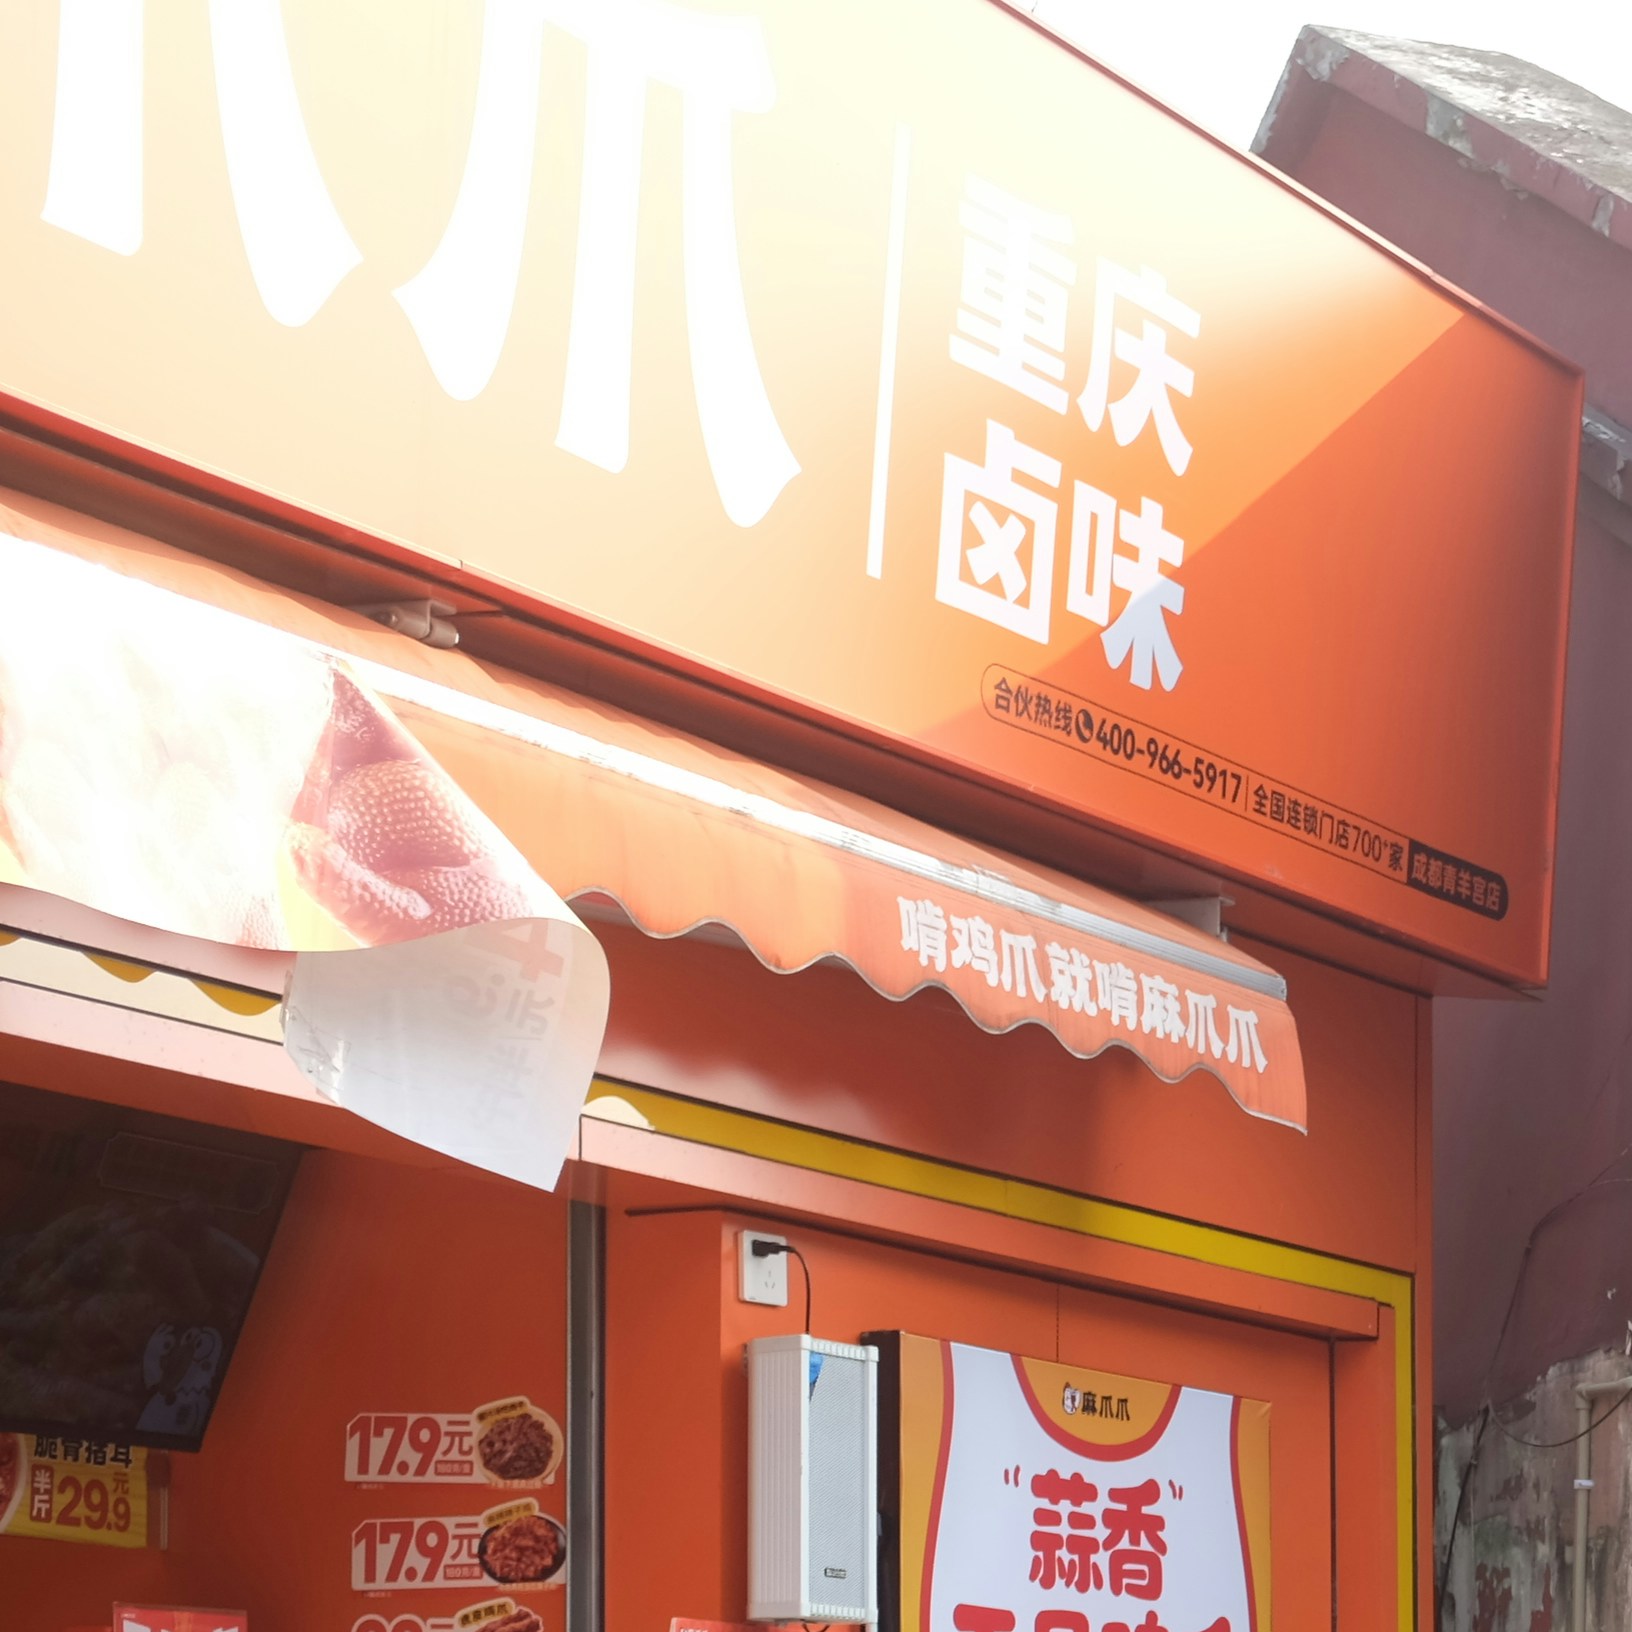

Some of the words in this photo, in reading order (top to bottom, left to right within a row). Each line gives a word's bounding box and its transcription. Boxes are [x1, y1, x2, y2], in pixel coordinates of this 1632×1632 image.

[947, 172, 1202, 476] 重庆
[935, 417, 1187, 694] 卤味
[992, 675, 1074, 738] 合伙热线
[1095, 721, 1243, 804] 400-966-5917
[1411, 849, 1501, 911] 成都青羊宫店
[895, 895, 1269, 1074] 啃鸡爪就啃麻爪爪
[31, 1469, 52, 1519] 半斤
[55, 1474, 132, 1533] 29.9
[1080, 1389, 1131, 1422] 麻爪爪
